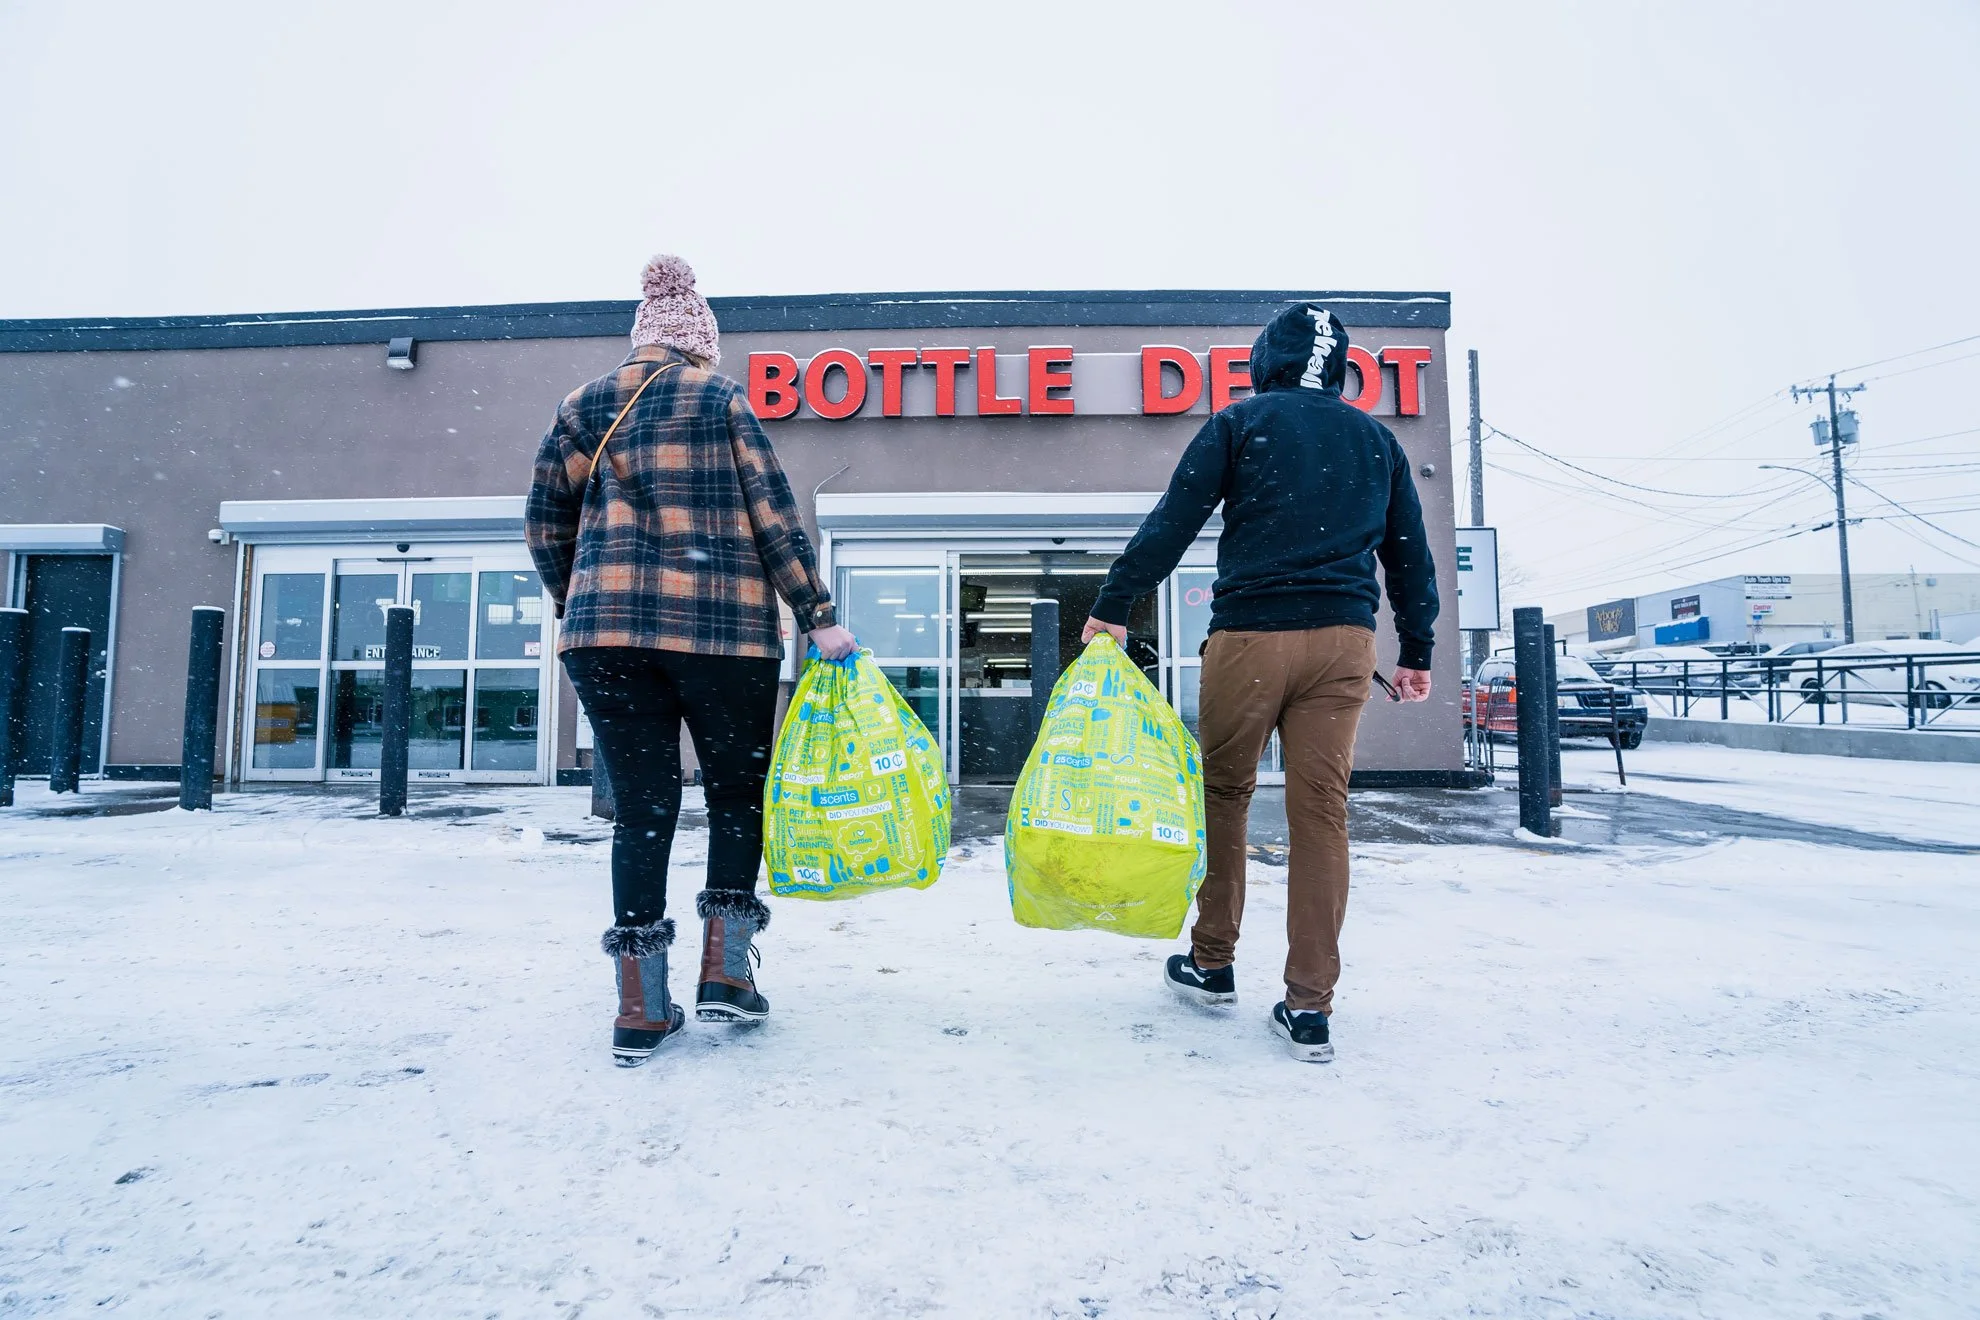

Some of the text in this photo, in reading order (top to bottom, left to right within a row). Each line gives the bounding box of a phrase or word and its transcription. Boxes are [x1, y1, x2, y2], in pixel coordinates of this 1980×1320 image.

[748, 344, 1430, 420] BOTTLE DEOT
[365, 646, 440, 660] ENTANCE
[829, 811, 842, 819] DID
[1034, 819, 1048, 827] DID
[1049, 821, 1065, 829] YOU
